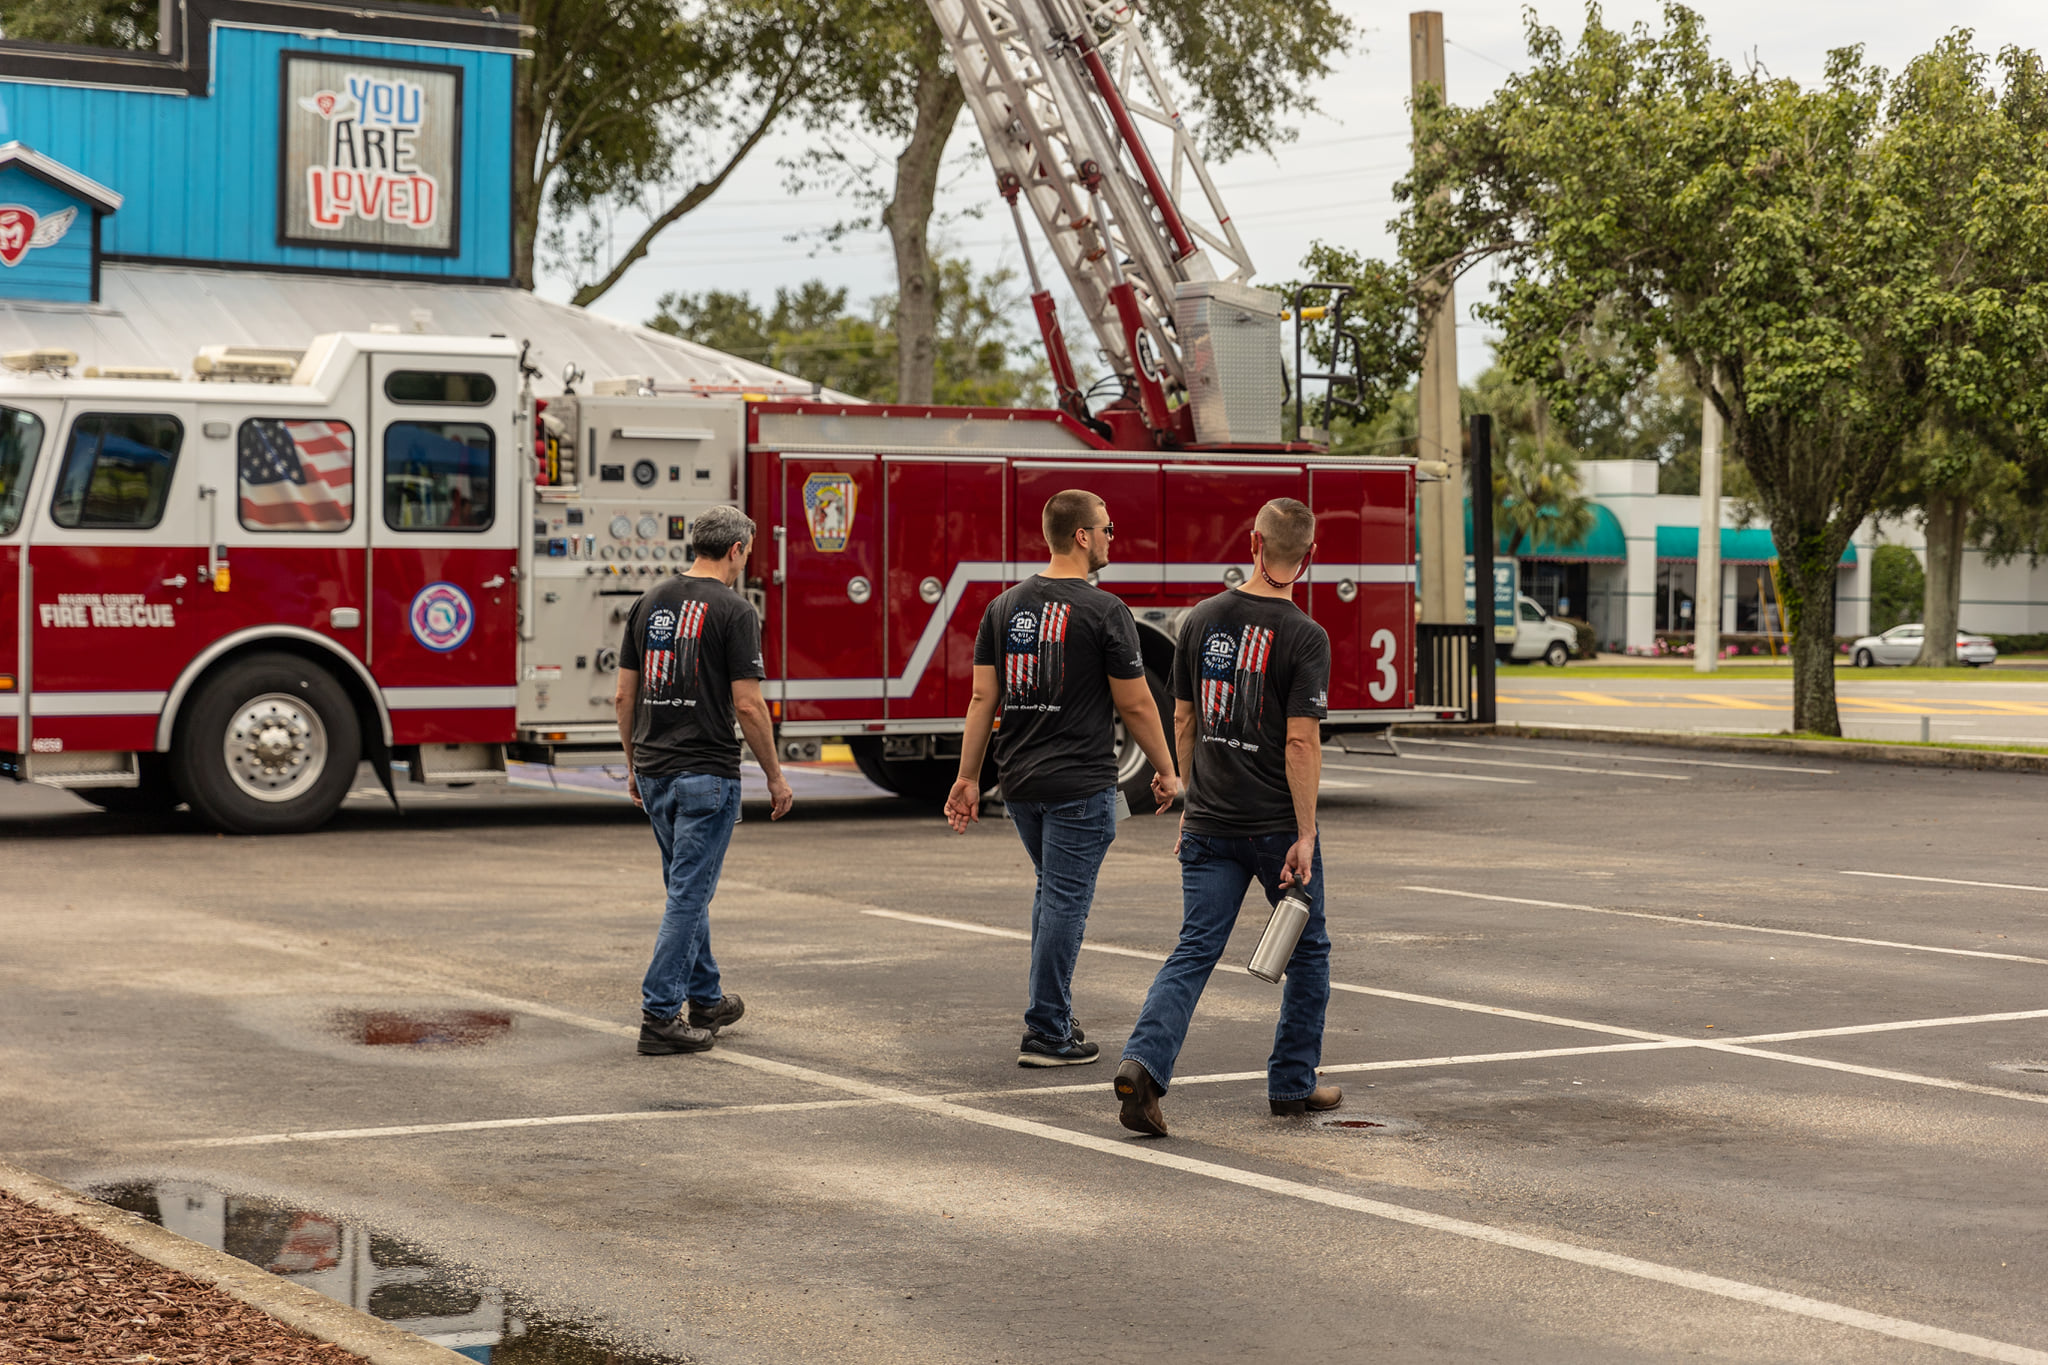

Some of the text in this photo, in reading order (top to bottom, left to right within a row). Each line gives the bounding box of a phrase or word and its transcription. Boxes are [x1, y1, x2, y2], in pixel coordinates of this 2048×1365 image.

[350, 78, 420, 125] YOU
[335, 118, 417, 174] ARE
[313, 171, 433, 224] LOVED
[39, 603, 175, 628] FIRE RESCUE
[1368, 628, 1398, 702] 3
